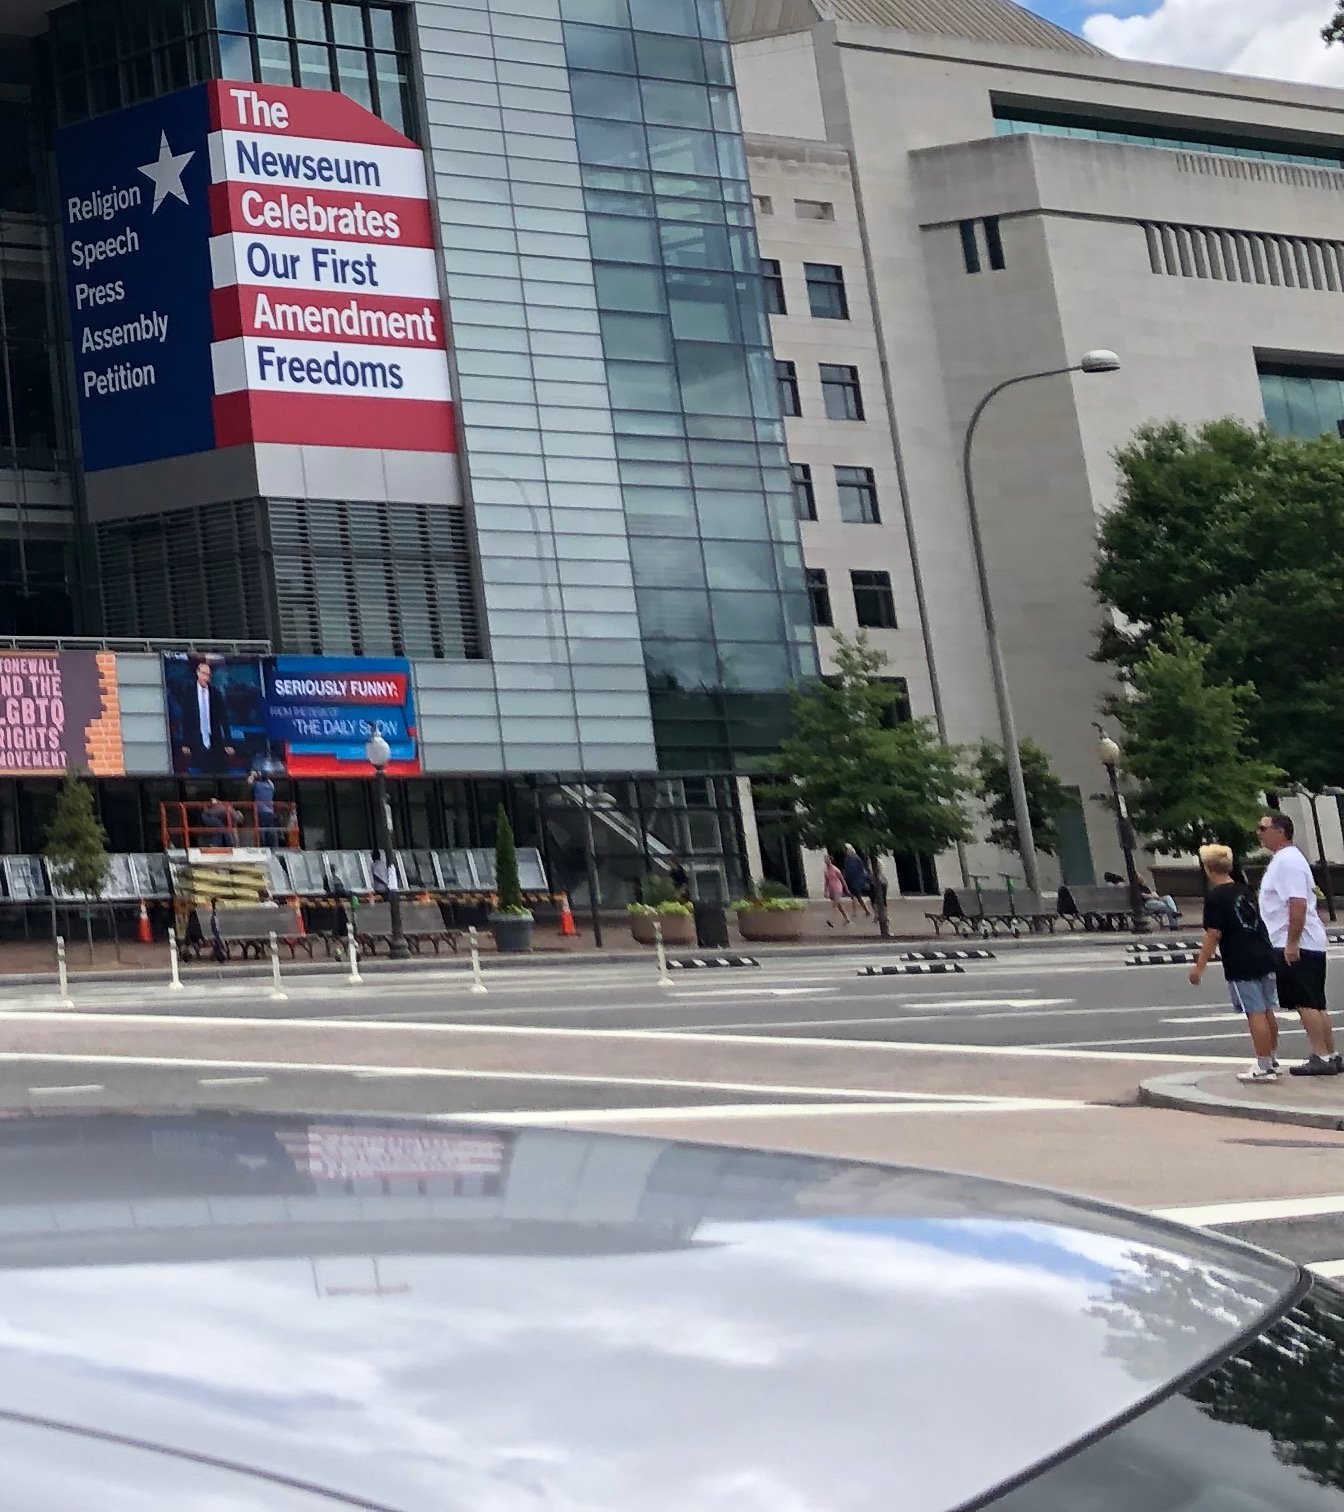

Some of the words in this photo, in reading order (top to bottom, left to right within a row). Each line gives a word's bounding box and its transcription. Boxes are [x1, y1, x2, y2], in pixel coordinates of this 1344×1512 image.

[229, 88, 289, 129] The
[236, 139, 380, 187] Newseum
[67, 184, 142, 224] Religion
[241, 191, 401, 240] Celebrates
[70, 227, 140, 269] Speech
[247, 242, 301, 281] Our
[313, 247, 379, 287] First
[75, 276, 125, 310] Press
[80, 310, 169, 354] Assembly
[253, 293, 436, 343] Amendment
[83, 360, 156, 399] Petition
[257, 346, 404, 390] Freedoms
[29, 675, 62, 697] THE
[275, 679, 346, 696] SERIOUSLY
[323, 719, 357, 736] DAILY
[359, 719, 398, 736] SOW
